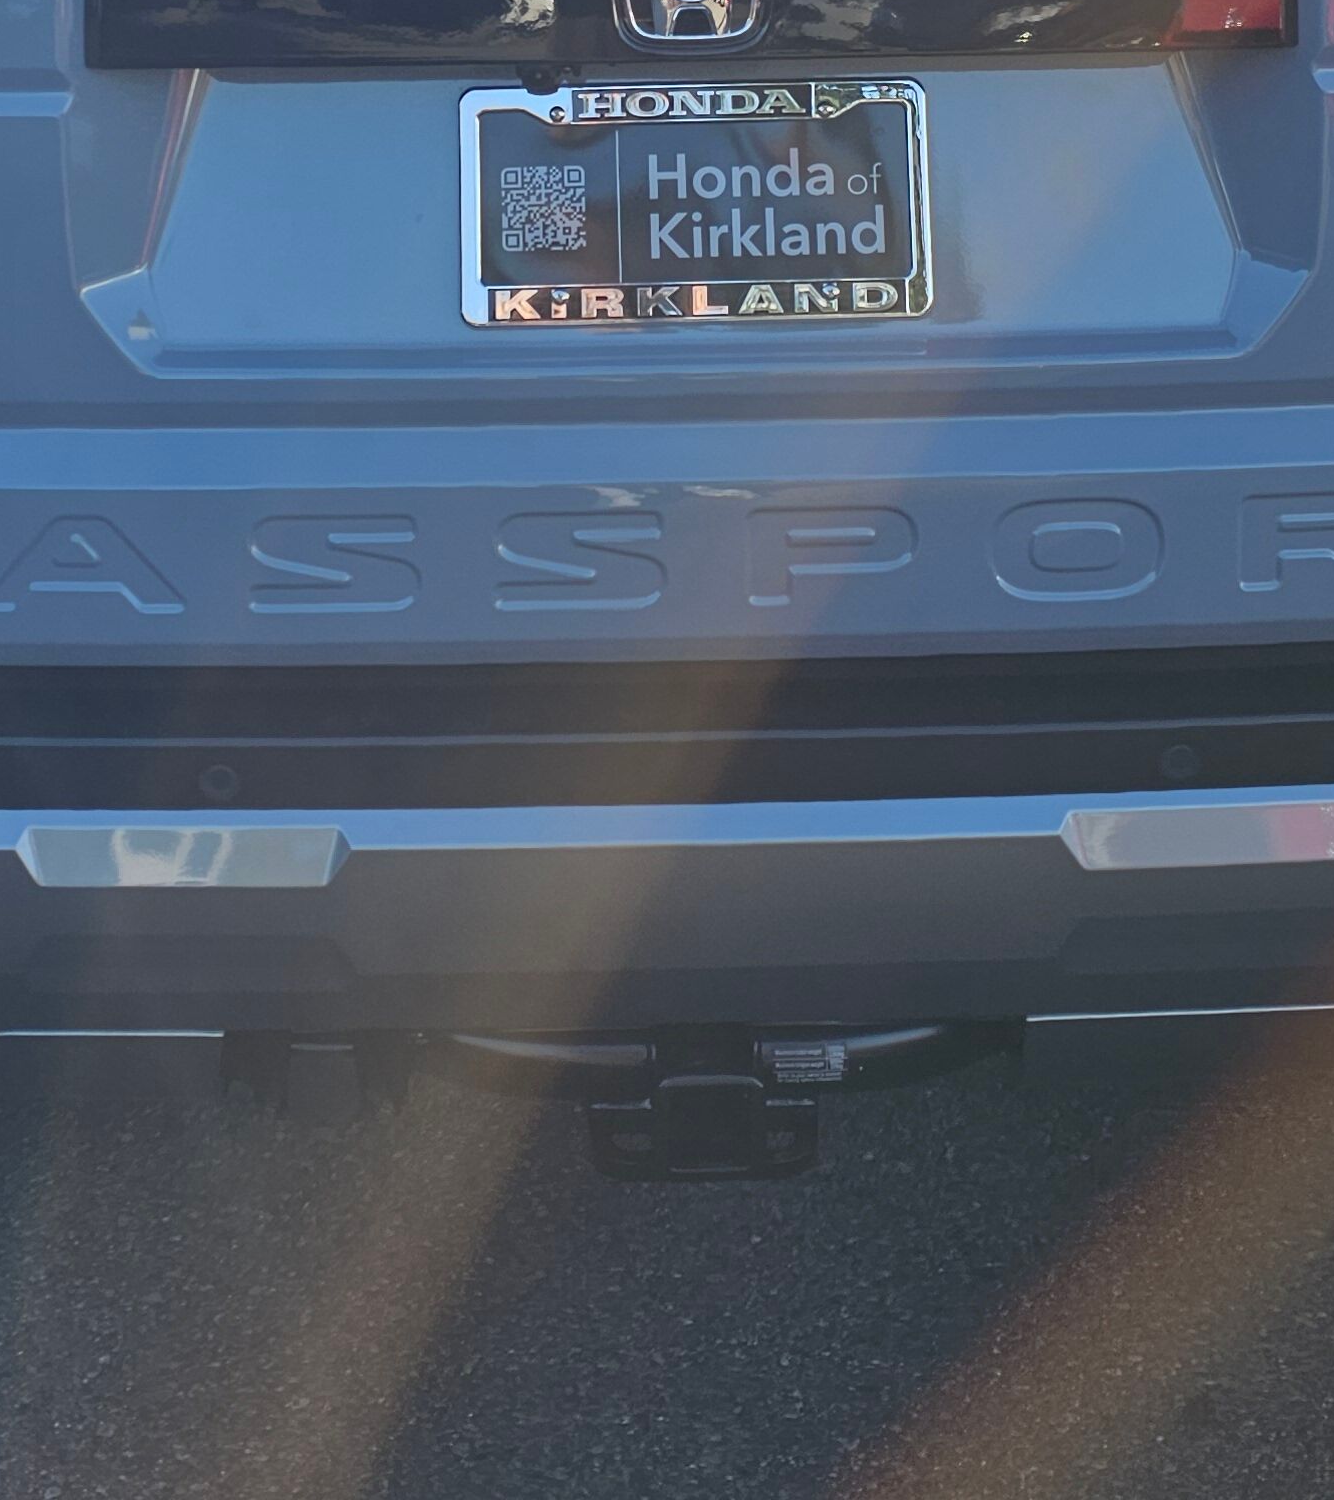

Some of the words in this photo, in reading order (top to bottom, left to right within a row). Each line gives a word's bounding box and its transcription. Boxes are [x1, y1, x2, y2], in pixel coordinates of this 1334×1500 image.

[577, 88, 806, 119] HONDA
[648, 147, 835, 200] Honda
[846, 161, 883, 196] of
[650, 204, 886, 260] Kirkland
[494, 281, 899, 321] KIRKLAND
